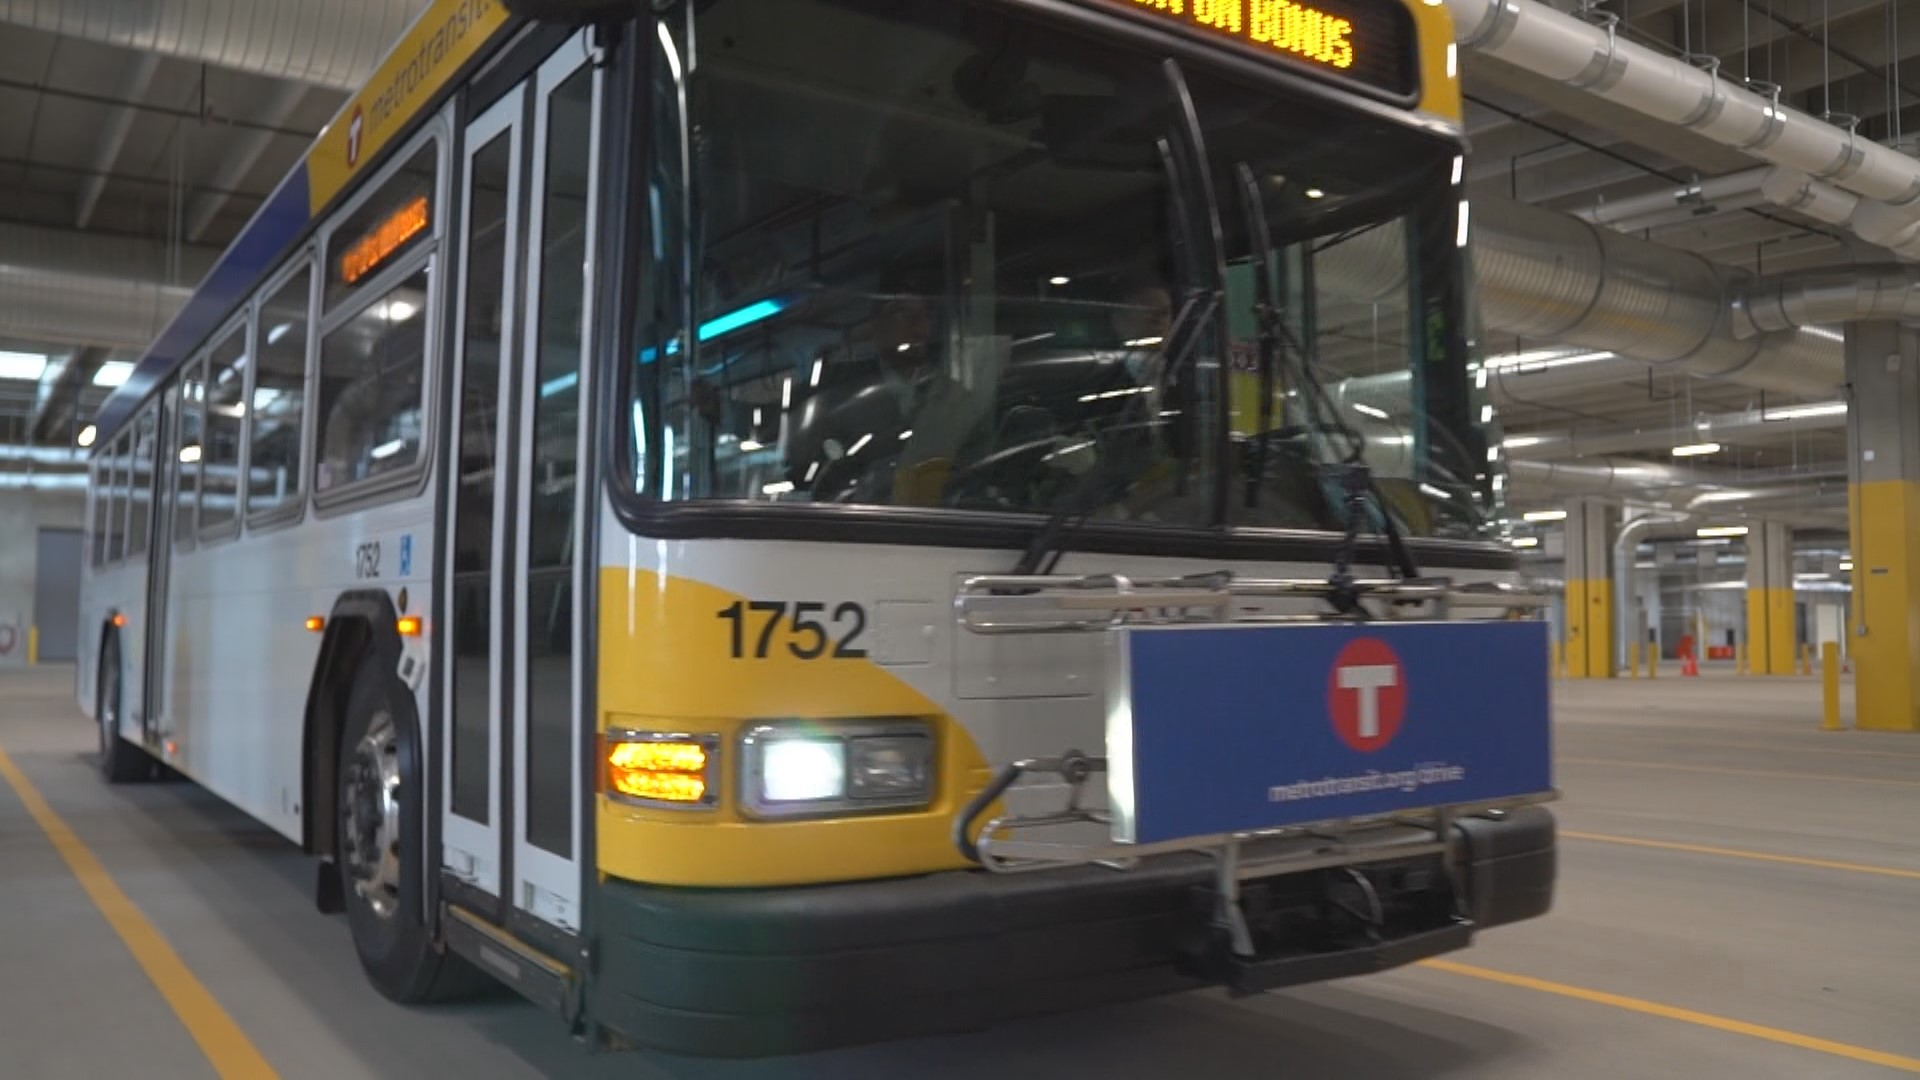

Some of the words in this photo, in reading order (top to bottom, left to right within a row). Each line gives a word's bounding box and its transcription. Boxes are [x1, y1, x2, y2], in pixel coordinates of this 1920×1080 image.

[1249, 0, 1353, 68] BONUS
[355, 541, 381, 580] 1752
[716, 601, 868, 660] 1752
[1336, 664, 1399, 739] T
